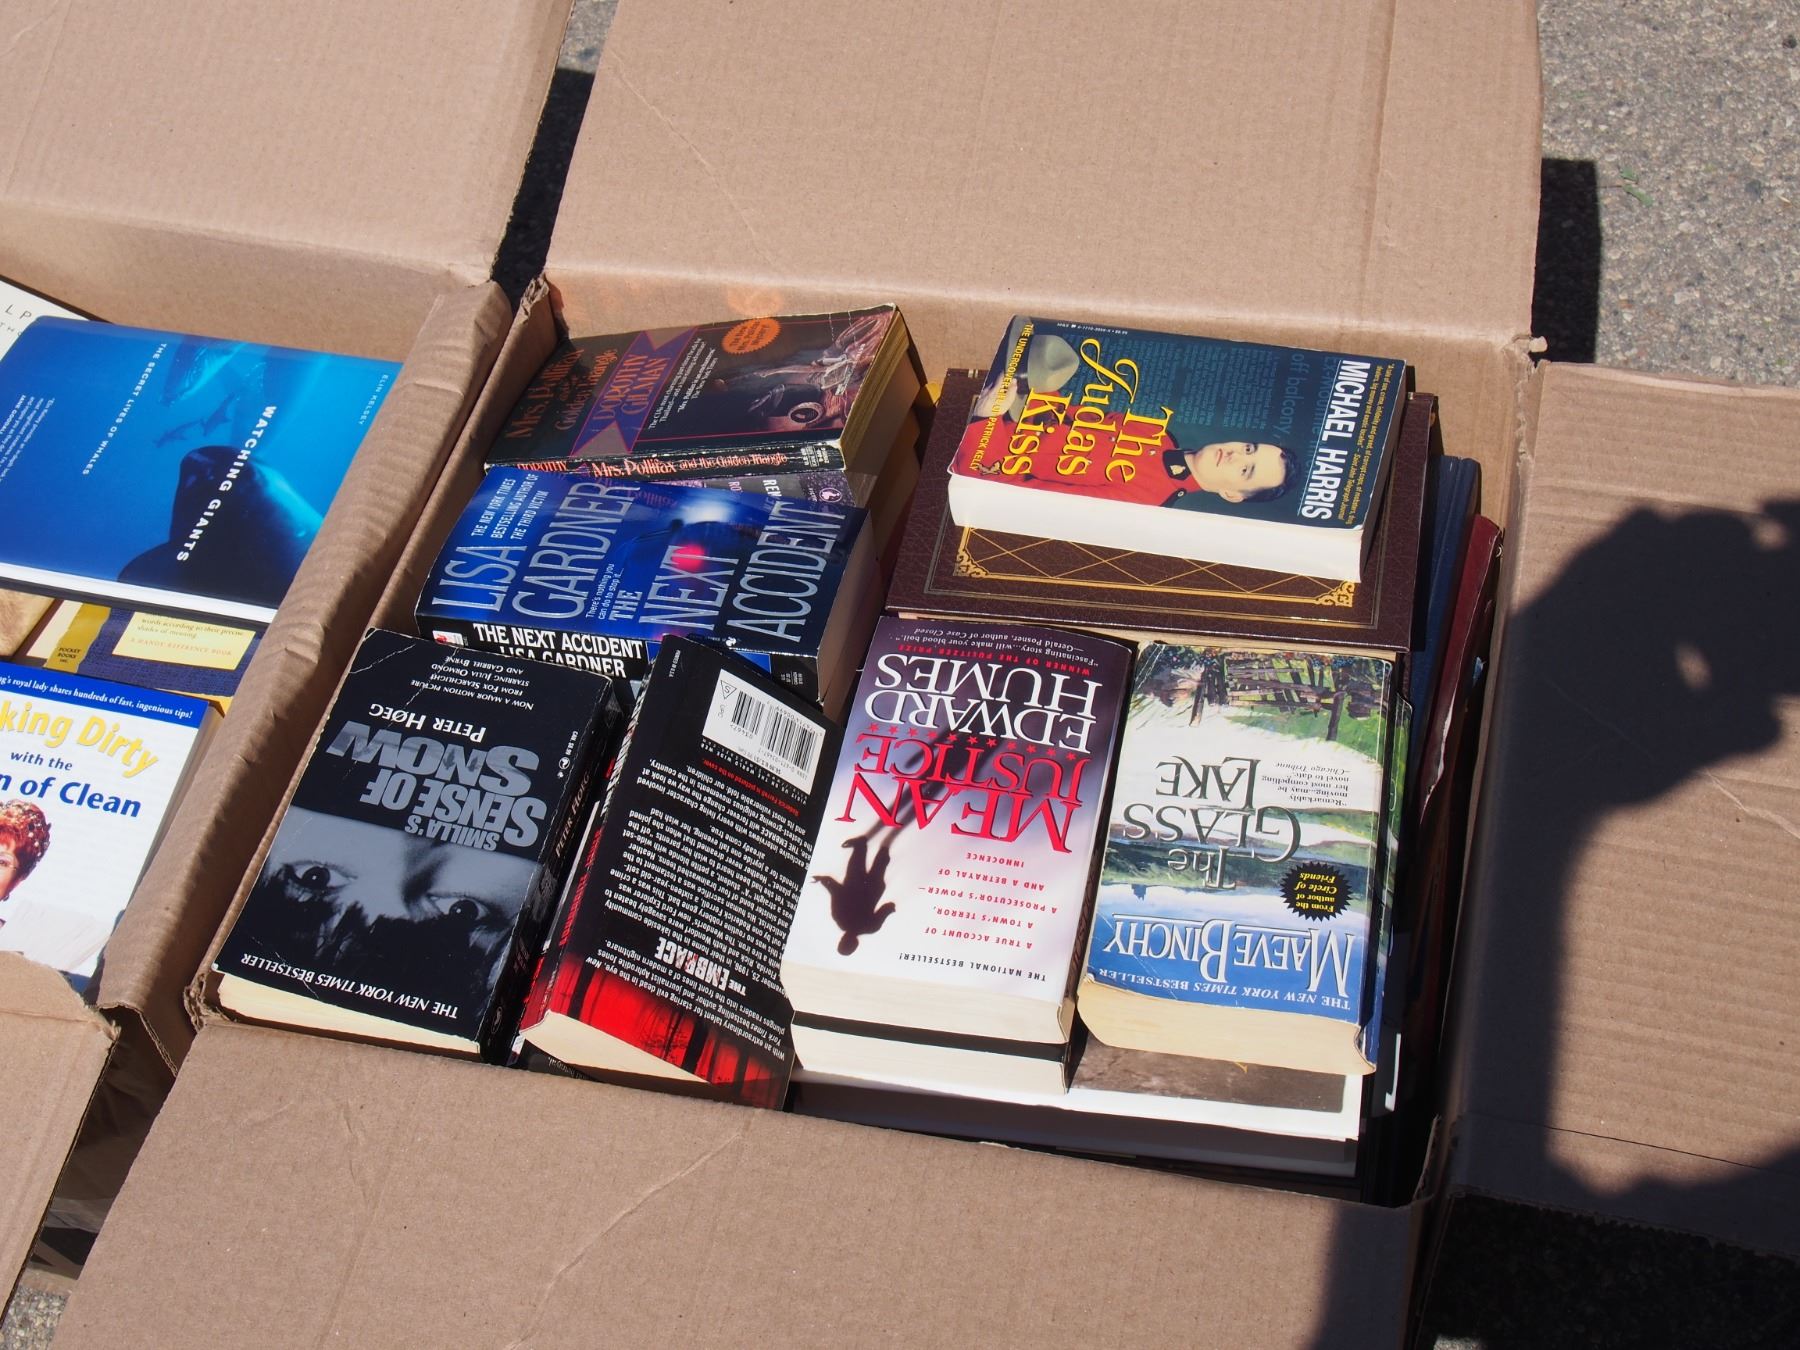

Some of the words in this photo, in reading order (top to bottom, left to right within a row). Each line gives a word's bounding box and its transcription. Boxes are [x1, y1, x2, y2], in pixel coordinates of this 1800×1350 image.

[1020, 323, 1034, 336] THE
[152, 343, 167, 359] THE
[999, 337, 1028, 386] UNDERCOVER
[132, 362, 156, 396] SECRET
[376, 374, 389, 393] ELIN
[592, 354, 648, 420] DOROTHY
[621, 357, 670, 414] GILMAN
[1057, 337, 1140, 478] Judas
[1321, 359, 1371, 441] MICHAEL
[115, 399, 134, 423] LIVES
[358, 394, 378, 425] KELSEY
[107, 426, 117, 438] OF
[976, 416, 998, 448] PATRICK
[1001, 388, 1068, 478] Kiss
[217, 405, 277, 492] WATCHING
[1104, 405, 1175, 484] The
[82, 440, 109, 475] WHALES
[590, 463, 625, 478] Mrs.
[625, 459, 677, 478] Pollifax
[679, 459, 698, 470] and
[699, 458, 716, 469] the
[716, 455, 751, 468] Golden
[751, 453, 787, 466] Triangle
[967, 449, 984, 471] KELLY
[496, 478, 516, 495] TIMES
[1301, 443, 1347, 522] HARRIS
[487, 495, 506, 510] YORK
[490, 501, 522, 539] BESTSELLING
[513, 481, 535, 502] AUTHOR
[525, 473, 539, 481] OF
[527, 490, 549, 509] VICTIM
[479, 510, 496, 524] NEW
[517, 509, 537, 527] THIRD
[176, 498, 222, 562] GIANTS
[471, 524, 488, 536] THE
[510, 527, 527, 540] THE
[512, 482, 640, 619] GARDNER
[432, 545, 526, 611] LISA
[609, 590, 641, 621] THE
[639, 546, 739, 630] NEXT
[727, 501, 847, 642] ACCIDENT
[585, 597, 601, 618] There's
[596, 574, 612, 596] nothing
[605, 563, 615, 574] you
[473, 623, 510, 645] THE
[511, 627, 556, 649] NEXT
[561, 633, 642, 659] ACCIDENT
[898, 645, 932, 653] PRIZE
[445, 656, 470, 667] BYRNE
[939, 648, 992, 659] PULITZER
[999, 654, 1018, 662] THE
[431, 663, 469, 677] ORMOND
[473, 661, 504, 673] GABRIEL
[506, 667, 524, 675] AND
[1045, 661, 1090, 676] WINNER
[430, 673, 481, 689] SEARCHLIGHT
[471, 671, 492, 681] JULIA
[493, 675, 530, 687] STARRING
[411, 679, 441, 691] PICTURE
[443, 686, 475, 698] MOTION
[483, 683, 499, 693] FOX
[501, 687, 523, 696] FROM
[875, 654, 1103, 718] HUMES
[12, 678, 32, 688] royal
[32, 680, 49, 691] lady
[49, 685, 72, 696] shares
[73, 689, 108, 703] hundreds
[109, 695, 118, 704] of
[136, 702, 173, 714] ingenious
[174, 709, 192, 719] tips!
[476, 693, 503, 703] MAJOR
[511, 700, 534, 710] NOW
[432, 717, 486, 743] PETER
[864, 690, 1096, 753] EDWARD
[76, 715, 159, 778] Dirty
[10, 752, 44, 765] with
[49, 757, 73, 771] the
[326, 720, 540, 796] SNOW
[854, 732, 1090, 805] JUSTICE
[360, 767, 417, 810] OF
[1155, 755, 1261, 810] LAKE
[19, 776, 56, 798] of
[59, 782, 142, 818] Clean
[414, 775, 548, 847] SENSE
[835, 772, 1081, 853] MEAN
[405, 815, 500, 850] SMILLA'S
[1123, 803, 1302, 864] GLASS
[967, 852, 1024, 868] INNOCENCE
[1167, 846, 1238, 890] The
[938, 868, 950, 876] OF
[956, 870, 1007, 885] BETRAYAL
[1299, 873, 1336, 884] Friends
[1024, 882, 1044, 891] AND
[1294, 881, 1306, 890] of
[1308, 884, 1337, 894] Circle
[969, 892, 1046, 912] PROSECUTOR'S
[1307, 894, 1335, 903] author
[933, 906, 977, 920] TERROR,
[1311, 903, 1334, 912] From
[981, 914, 1021, 927] TOWN'S
[925, 927, 937, 935] OF
[942, 929, 990, 942] ACCOUNT
[995, 937, 1020, 947] TRUE
[1103, 919, 1234, 983] BINCHY
[241, 953, 315, 984] BESTSELLER
[585, 956, 602, 969] New
[654, 936, 729, 990] EMBRACE
[899, 952, 965, 968] BESTSELLER!
[1232, 928, 1356, 998] MAEVE
[619, 970, 631, 981] the
[970, 962, 1022, 977] NATIONAL
[1028, 972, 1045, 981] THE
[315, 973, 356, 993] TIMES
[631, 976, 639, 986] in
[638, 979, 656, 993] dead
[728, 979, 746, 996] THE
[1099, 969, 1189, 991] BESTSELLER
[1194, 982, 1237, 995] TIMES
[355, 983, 394, 1003] YORK
[656, 988, 669, 998] evil
[669, 992, 693, 1010] staring
[1242, 986, 1279, 1000] YORK
[1284, 990, 1316, 1004] NEW
[394, 994, 430, 1011] NEW
[431, 1002, 458, 1019] THE
[1321, 996, 1351, 1010] THE
[693, 1006, 703, 1017] for
[704, 1011, 723, 1026] talent
[723, 1019, 766, 1046] extraordinary
[764, 1042, 772, 1051] an
[772, 1047, 785, 1061] With
